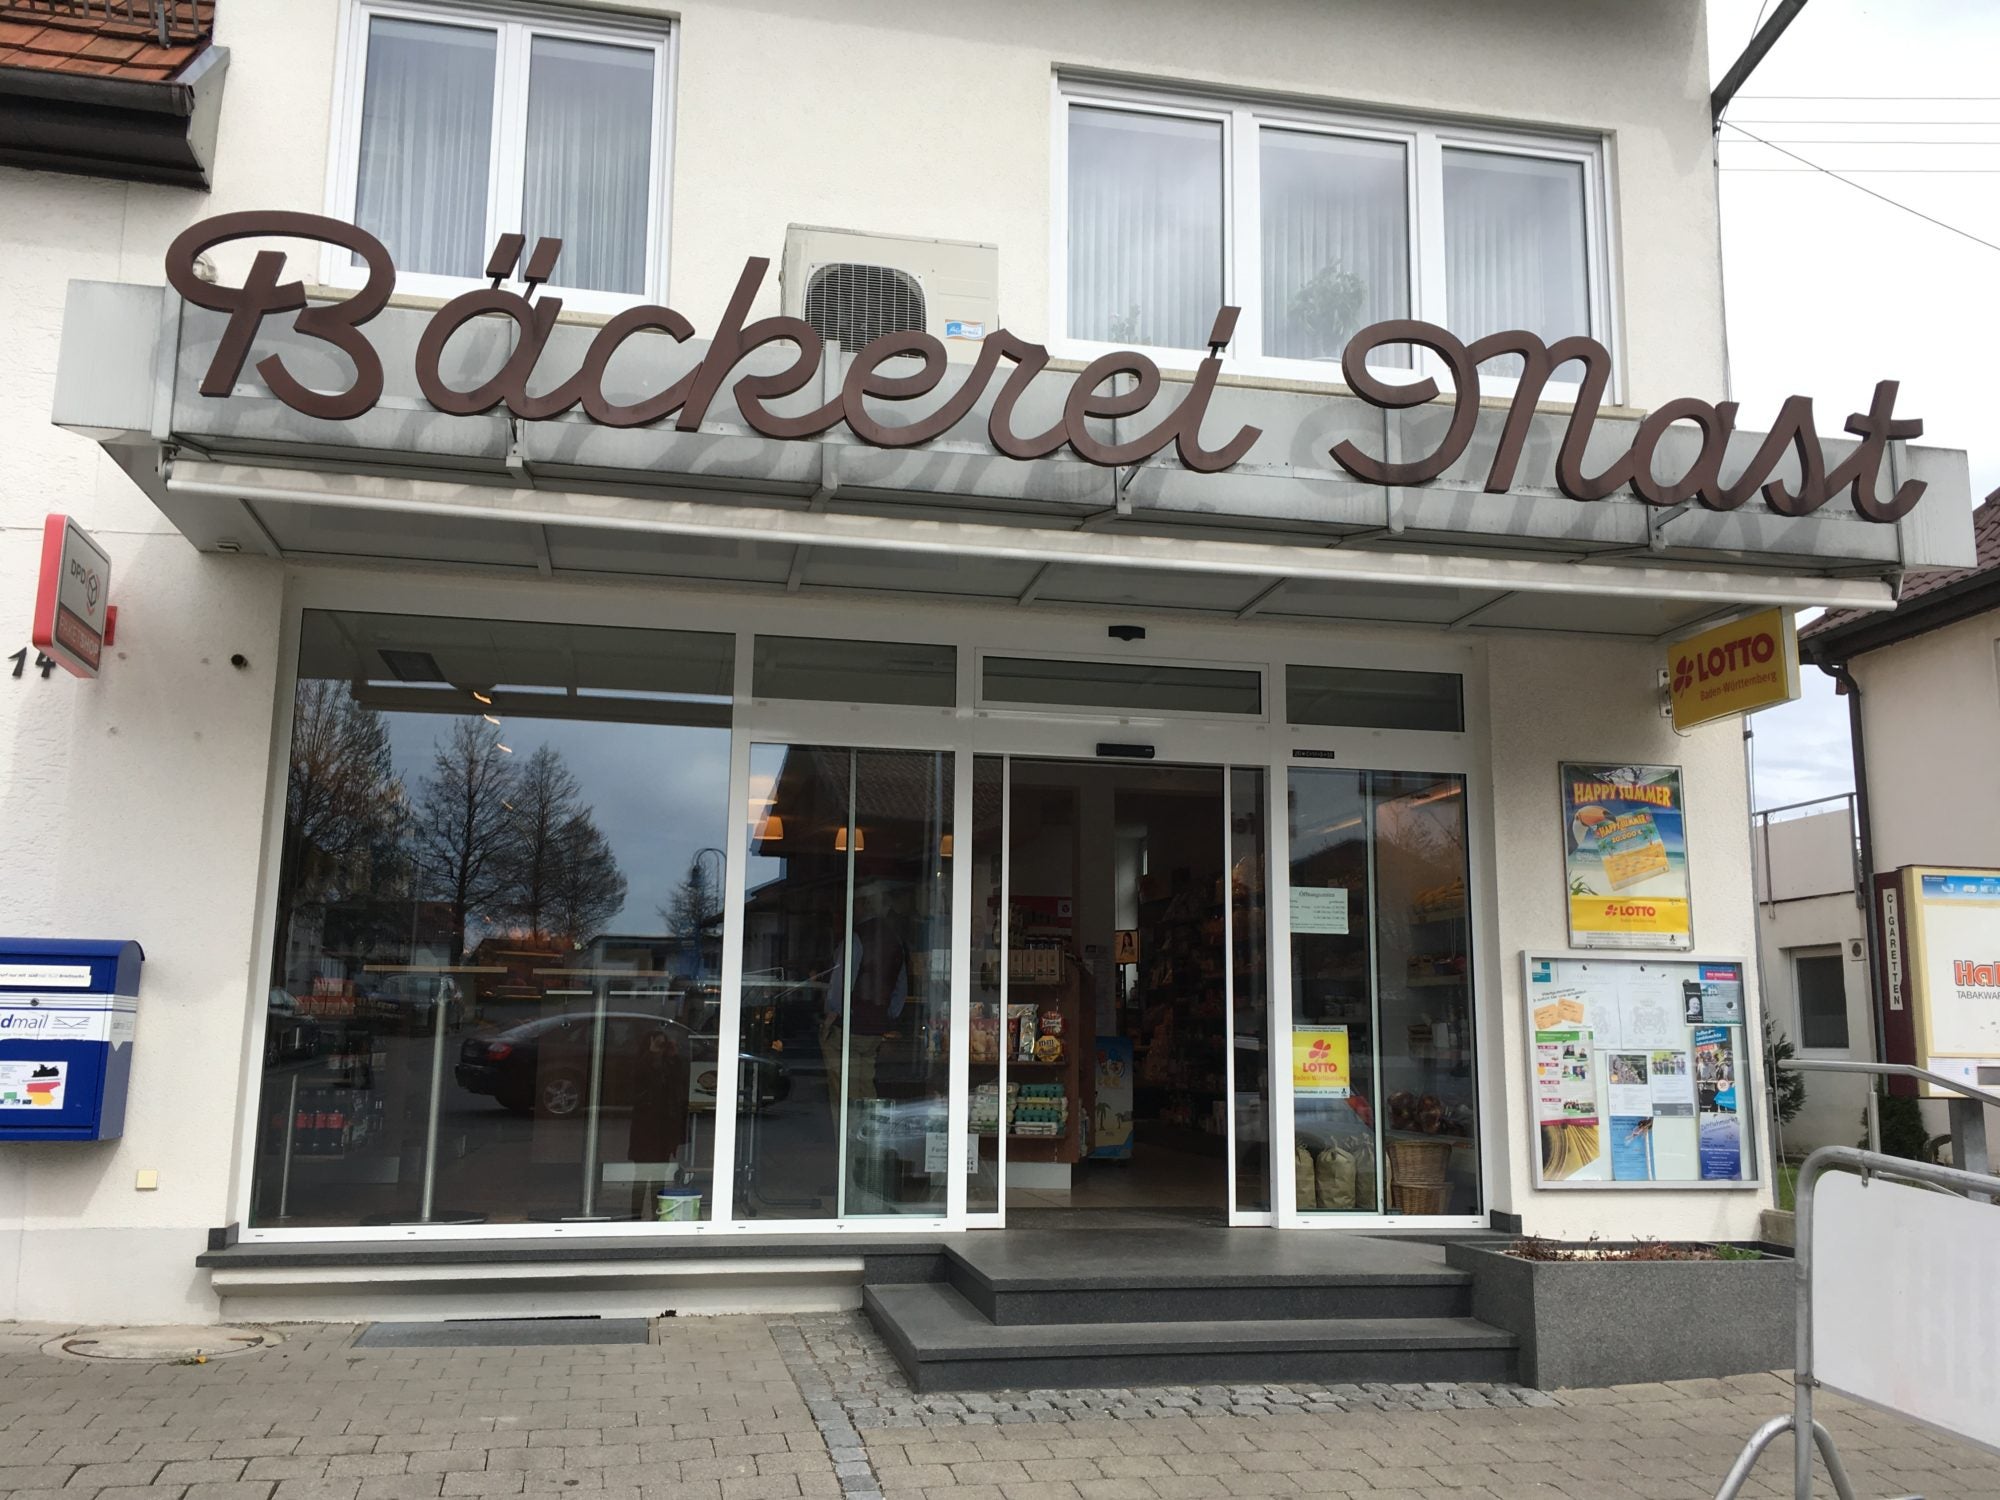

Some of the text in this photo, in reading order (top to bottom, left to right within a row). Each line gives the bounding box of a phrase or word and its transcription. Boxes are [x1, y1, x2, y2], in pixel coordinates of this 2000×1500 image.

[165, 210, 1925, 524] Bäckerei Mast
[70, 558, 87, 586] DPD
[8, 647, 57, 679] 14
[1697, 633, 1775, 682] LOTTO
[1700, 671, 1777, 702] Baden-Württemberg
[1573, 783, 1672, 808] HAPPY SUMMER
[1620, 906, 1656, 917] LOTTO
[1887, 893, 1900, 1005] CIGARETTEN
[1302, 1063, 1338, 1073] LOTTO
